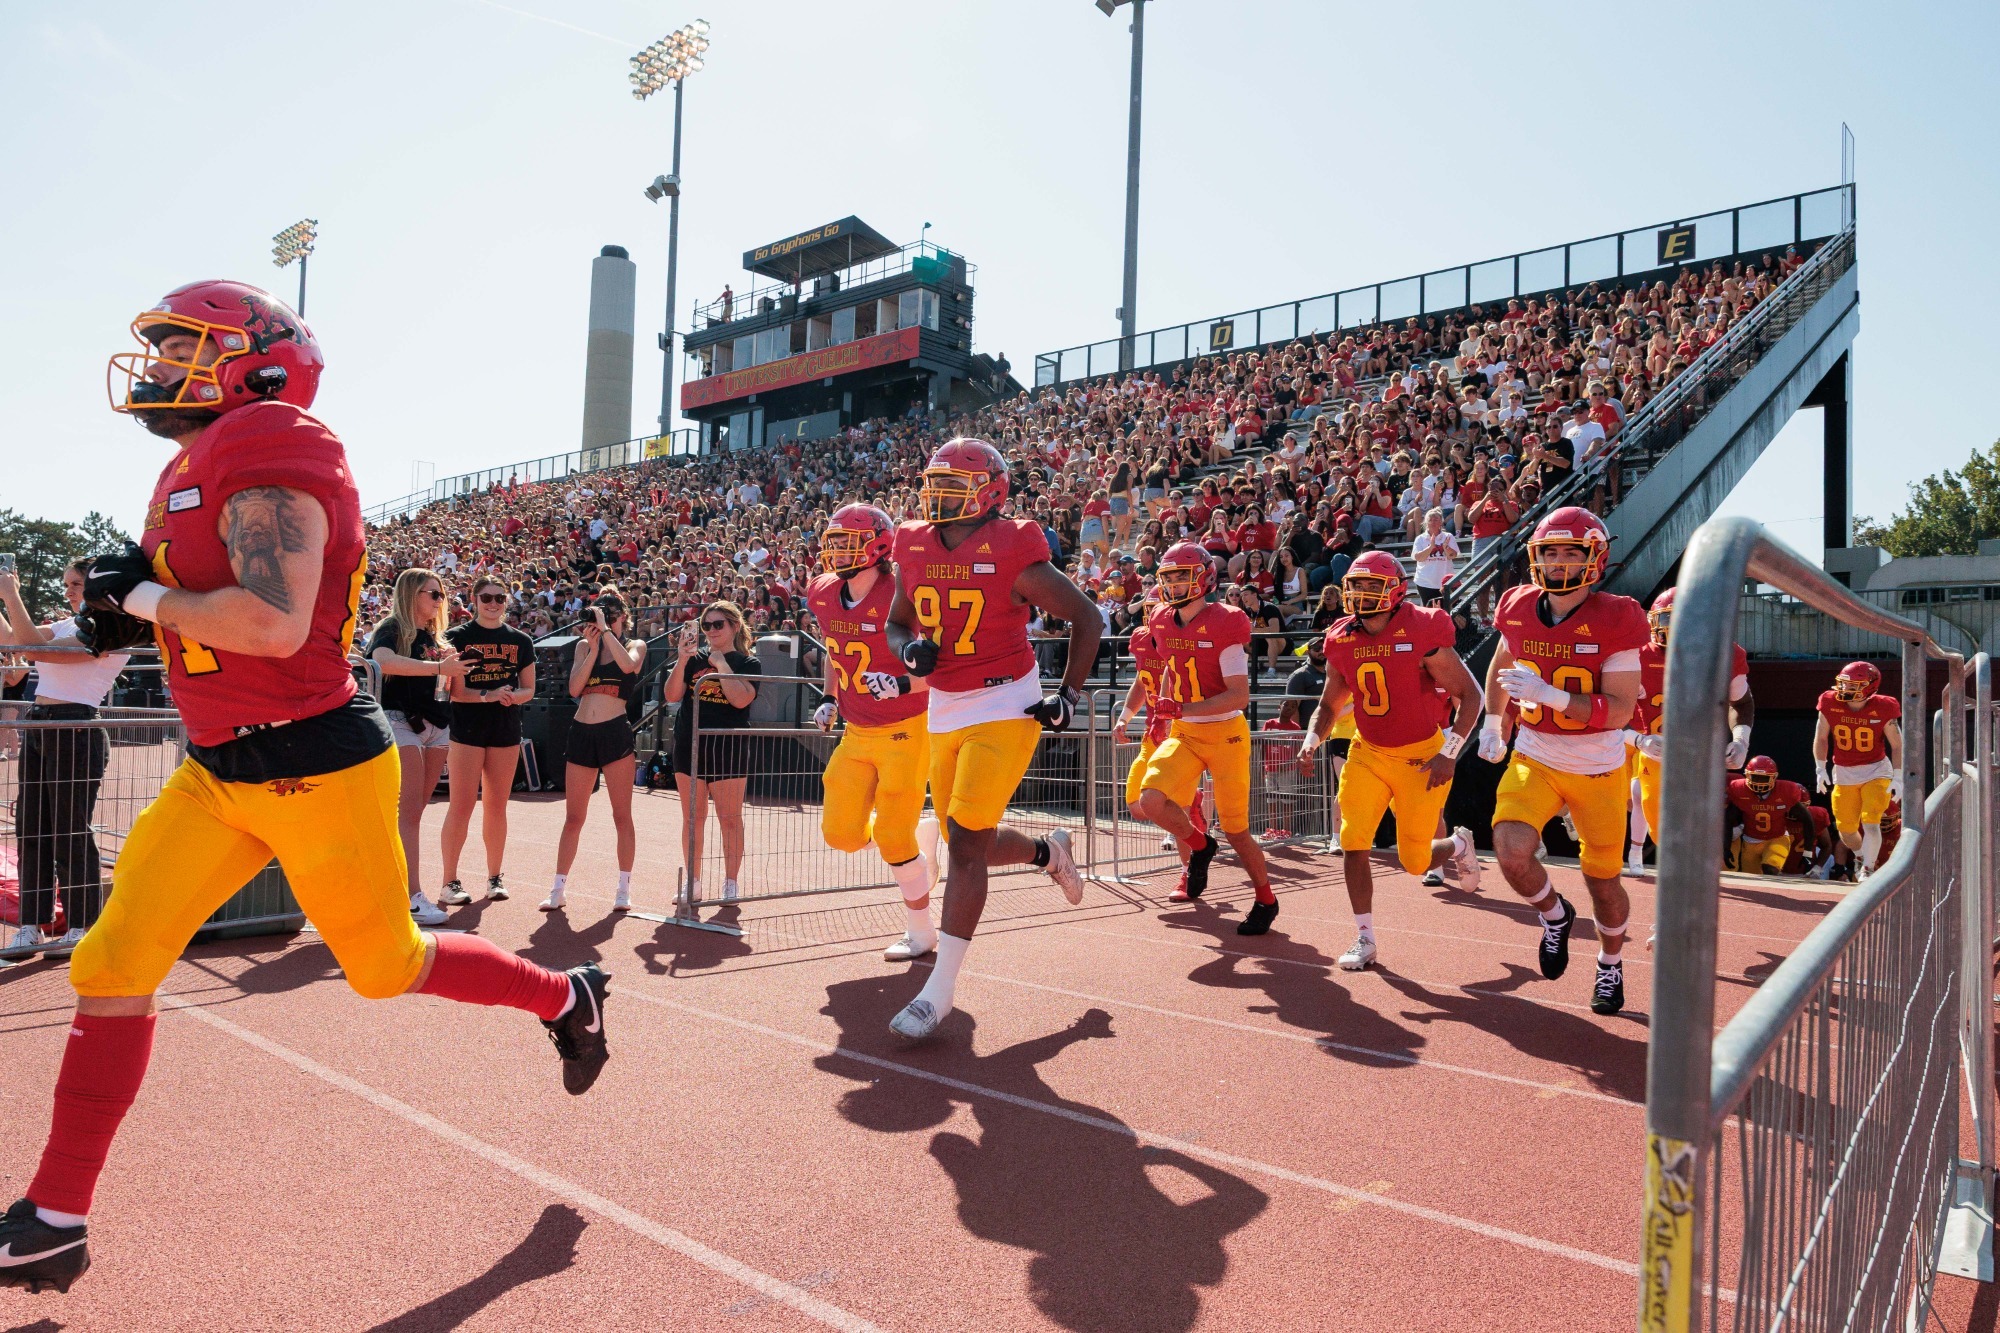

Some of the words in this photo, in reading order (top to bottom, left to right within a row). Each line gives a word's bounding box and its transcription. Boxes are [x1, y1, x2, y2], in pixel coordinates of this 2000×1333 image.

[754, 248, 769, 261] Go
[770, 230, 822, 255] Gryphons
[823, 224, 840, 238] Go
[1663, 230, 1690, 259] E
[1212, 325, 1232, 347] D
[725, 358, 799, 396] UNIVERSITY
[805, 345, 860, 378] GUELPH
[796, 420, 808, 437] C
[925, 563, 970, 580] GUELPH
[829, 619, 860, 636] GUELPH
[913, 584, 986, 656] 97
[1165, 638, 1196, 651] GUELPH
[1353, 644, 1391, 659] GUELPH
[1523, 639, 1571, 659] GUELPH
[825, 635, 872, 695] 62
[1144, 658, 1166, 670] GUELP
[1167, 654, 1206, 704] 11
[1356, 661, 1391, 716] 0
[1840, 715, 1868, 726] GUELPH
[1833, 724, 1874, 753] 88
[1751, 804, 1775, 812] GUELPH
